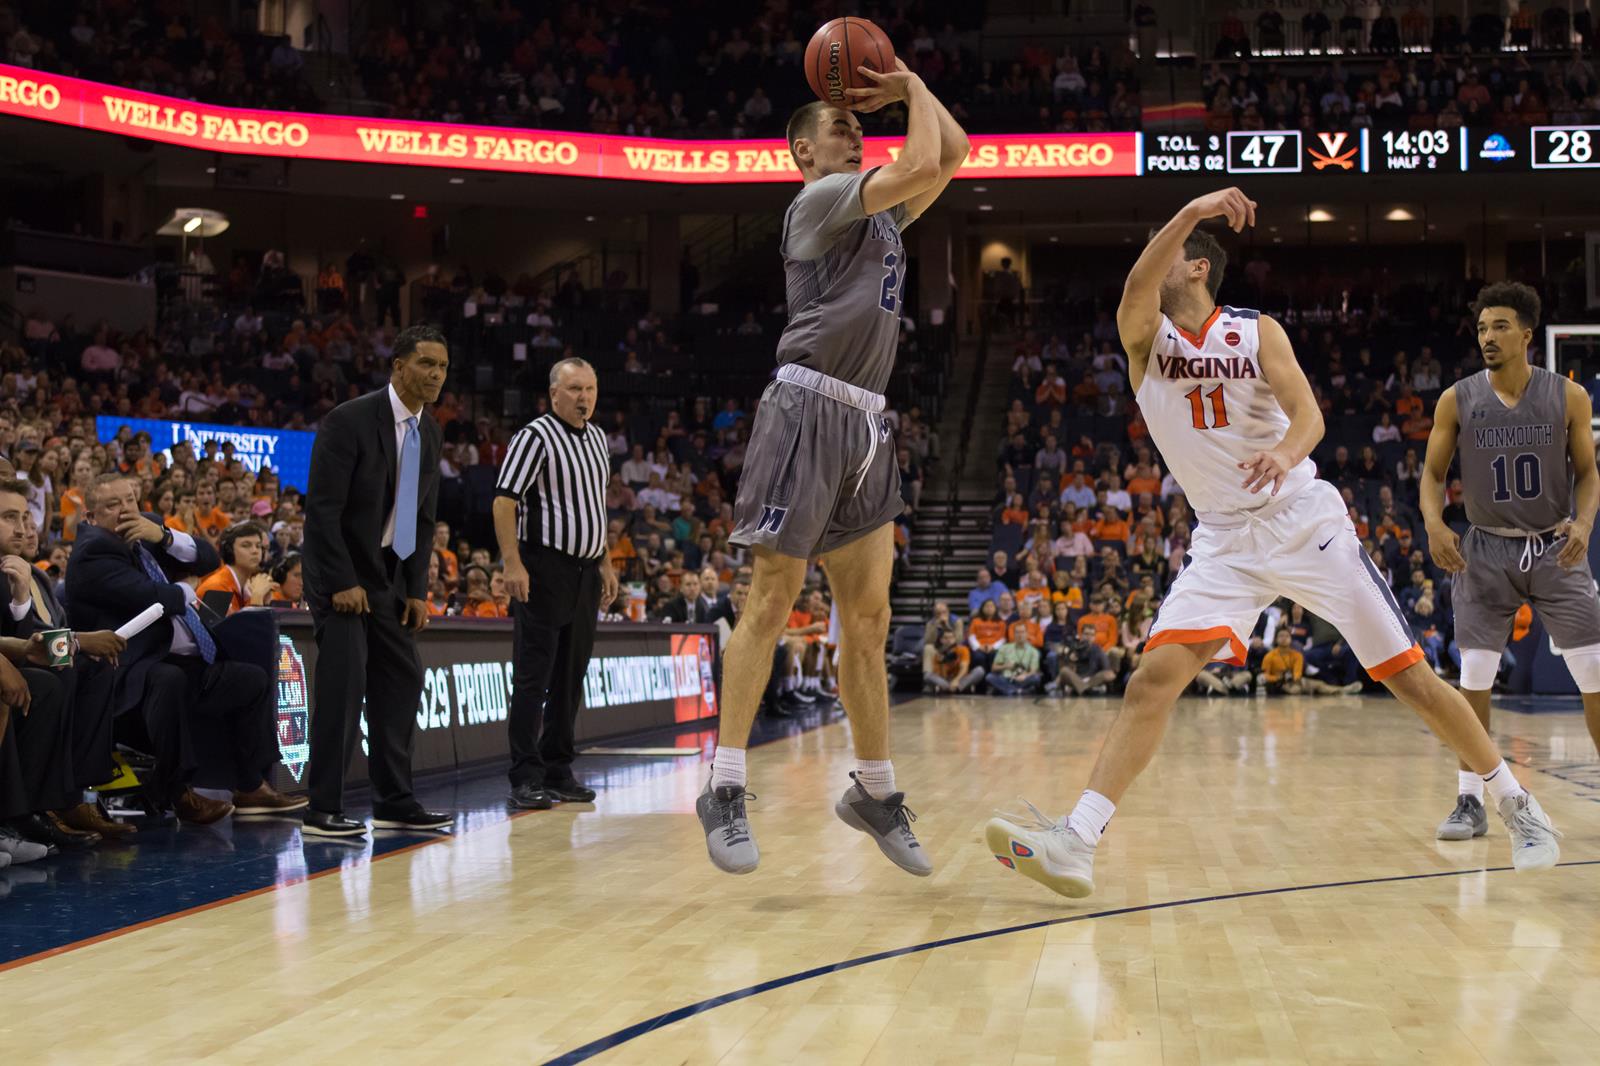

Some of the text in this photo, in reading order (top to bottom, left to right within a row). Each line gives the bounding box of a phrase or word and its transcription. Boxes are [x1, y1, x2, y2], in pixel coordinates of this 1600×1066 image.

[103, 95, 309, 147] WELLS FARGO
[357, 128, 579, 166] WELLS FARGO
[1004, 143, 1114, 168] FARGO
[1157, 135, 1219, 151] T.O.L. 3
[1241, 137, 1285, 167] 47
[1382, 130, 1450, 155] 14:03
[1549, 130, 1592, 163] 28
[623, 146, 800, 174] WELLS FAR
[1147, 155, 1225, 171] FOULS 02
[1387, 155, 1437, 169] HALF 2
[1156, 353, 1257, 379] VIRGINIA
[1184, 382, 1231, 430] 11
[1475, 424, 1553, 449] MONMOUTH
[1491, 452, 1542, 503] 10
[452, 662, 508, 726] PROUD
